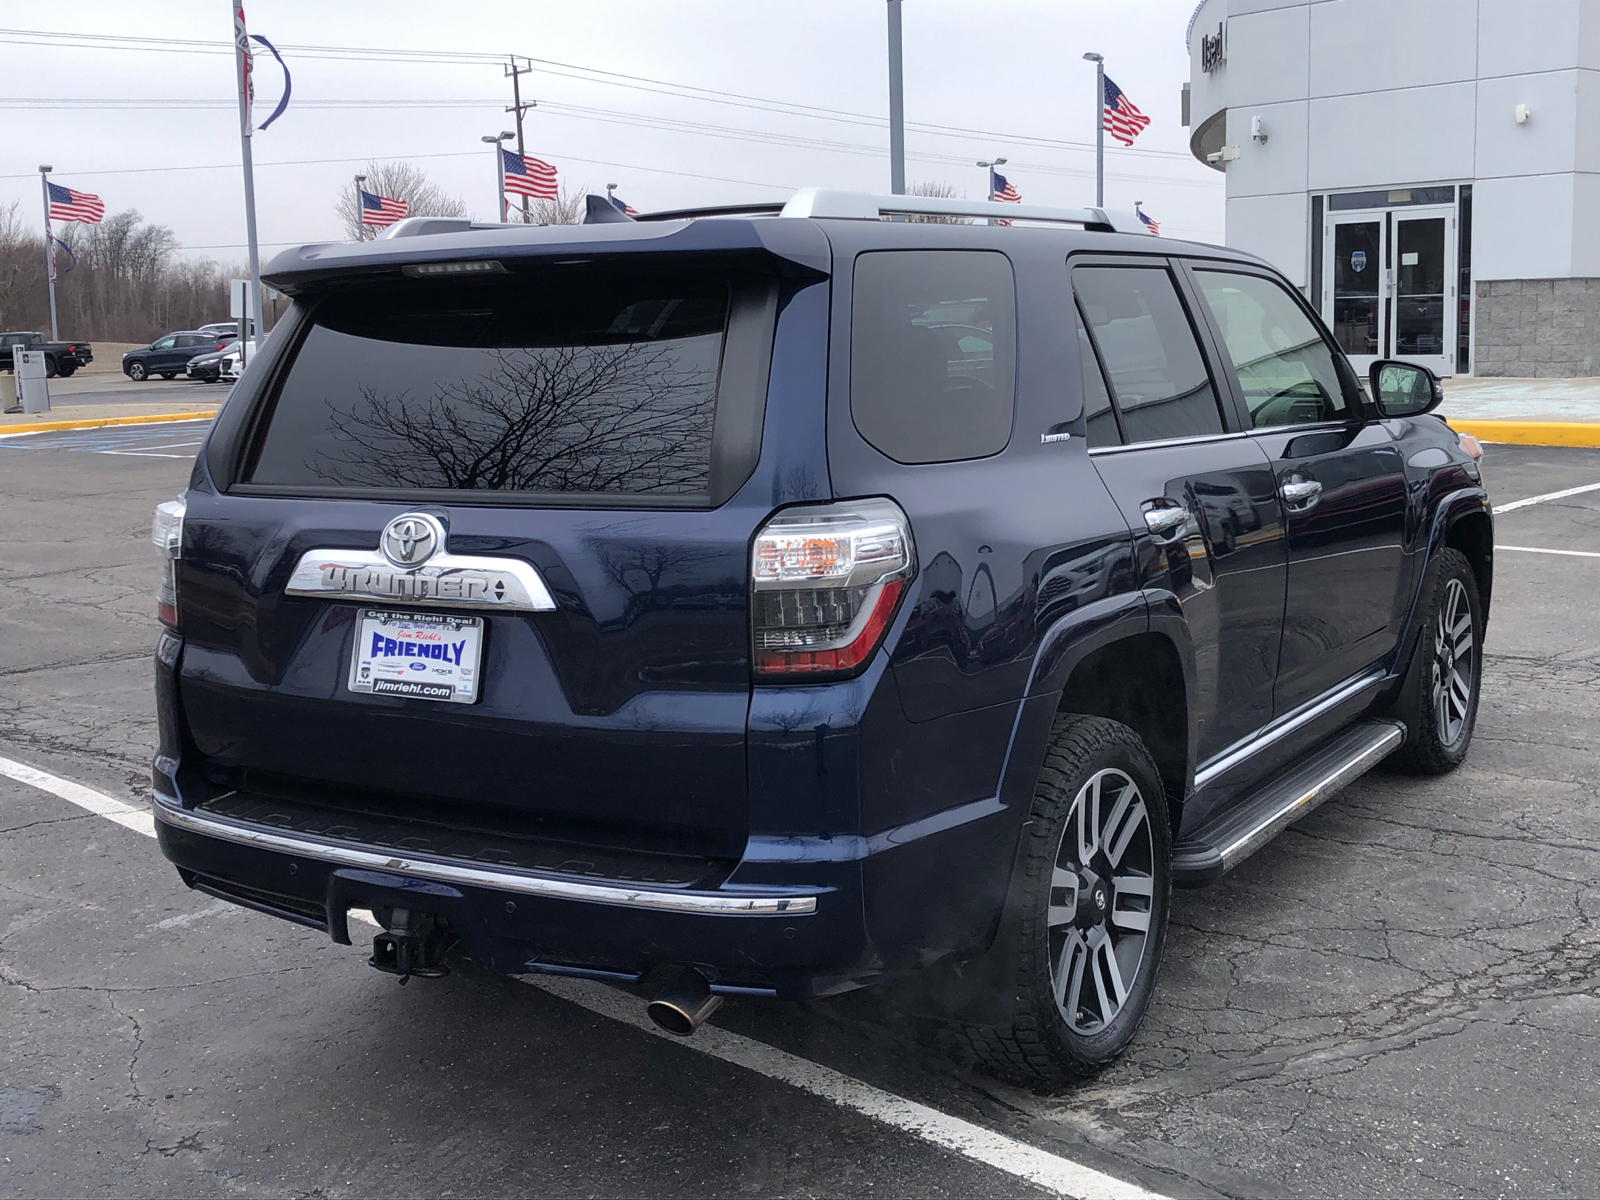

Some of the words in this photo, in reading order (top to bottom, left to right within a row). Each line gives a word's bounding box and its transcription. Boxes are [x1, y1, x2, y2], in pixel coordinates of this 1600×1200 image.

[1202, 21, 1223, 73] Used
[321, 567, 488, 600] 4RUNNER
[368, 611, 389, 619] Get
[392, 612, 410, 620] the
[413, 614, 446, 622] Riehl
[446, 616, 473, 625] Deal
[396, 629, 412, 640] Jim
[415, 631, 442, 641] Riehl's
[371, 631, 467, 667] FRIENDLY
[374, 680, 450, 697] jimriehl.com
